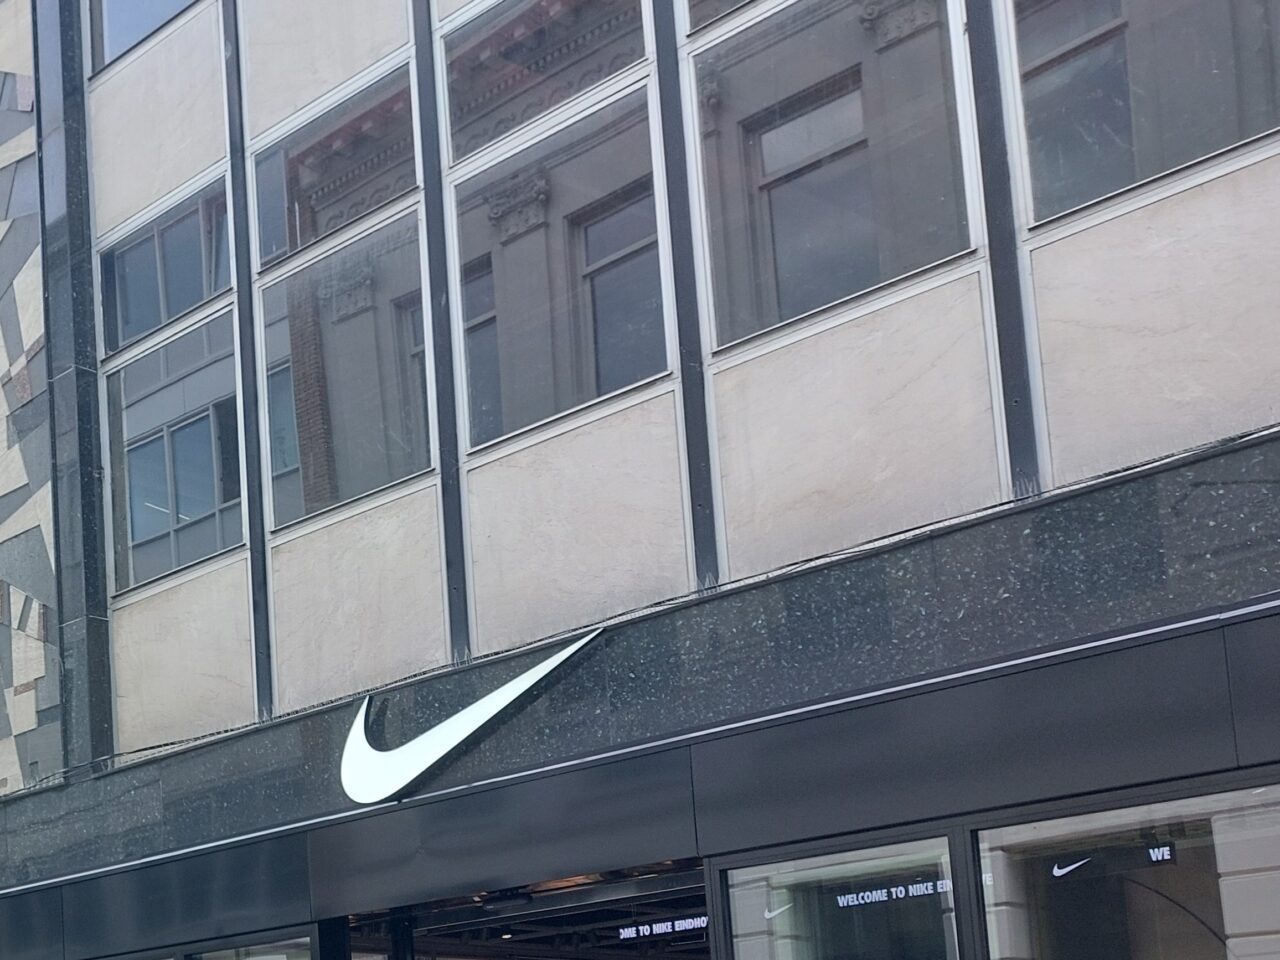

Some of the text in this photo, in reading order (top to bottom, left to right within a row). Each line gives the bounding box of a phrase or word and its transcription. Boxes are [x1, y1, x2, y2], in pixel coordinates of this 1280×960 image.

[1149, 846, 1171, 861] WE
[837, 889, 888, 907] WELCOME
[890, 886, 905, 898] TO
[908, 882, 934, 897] NIKE
[638, 925, 650, 936] TO
[652, 921, 672, 935] NIKE
